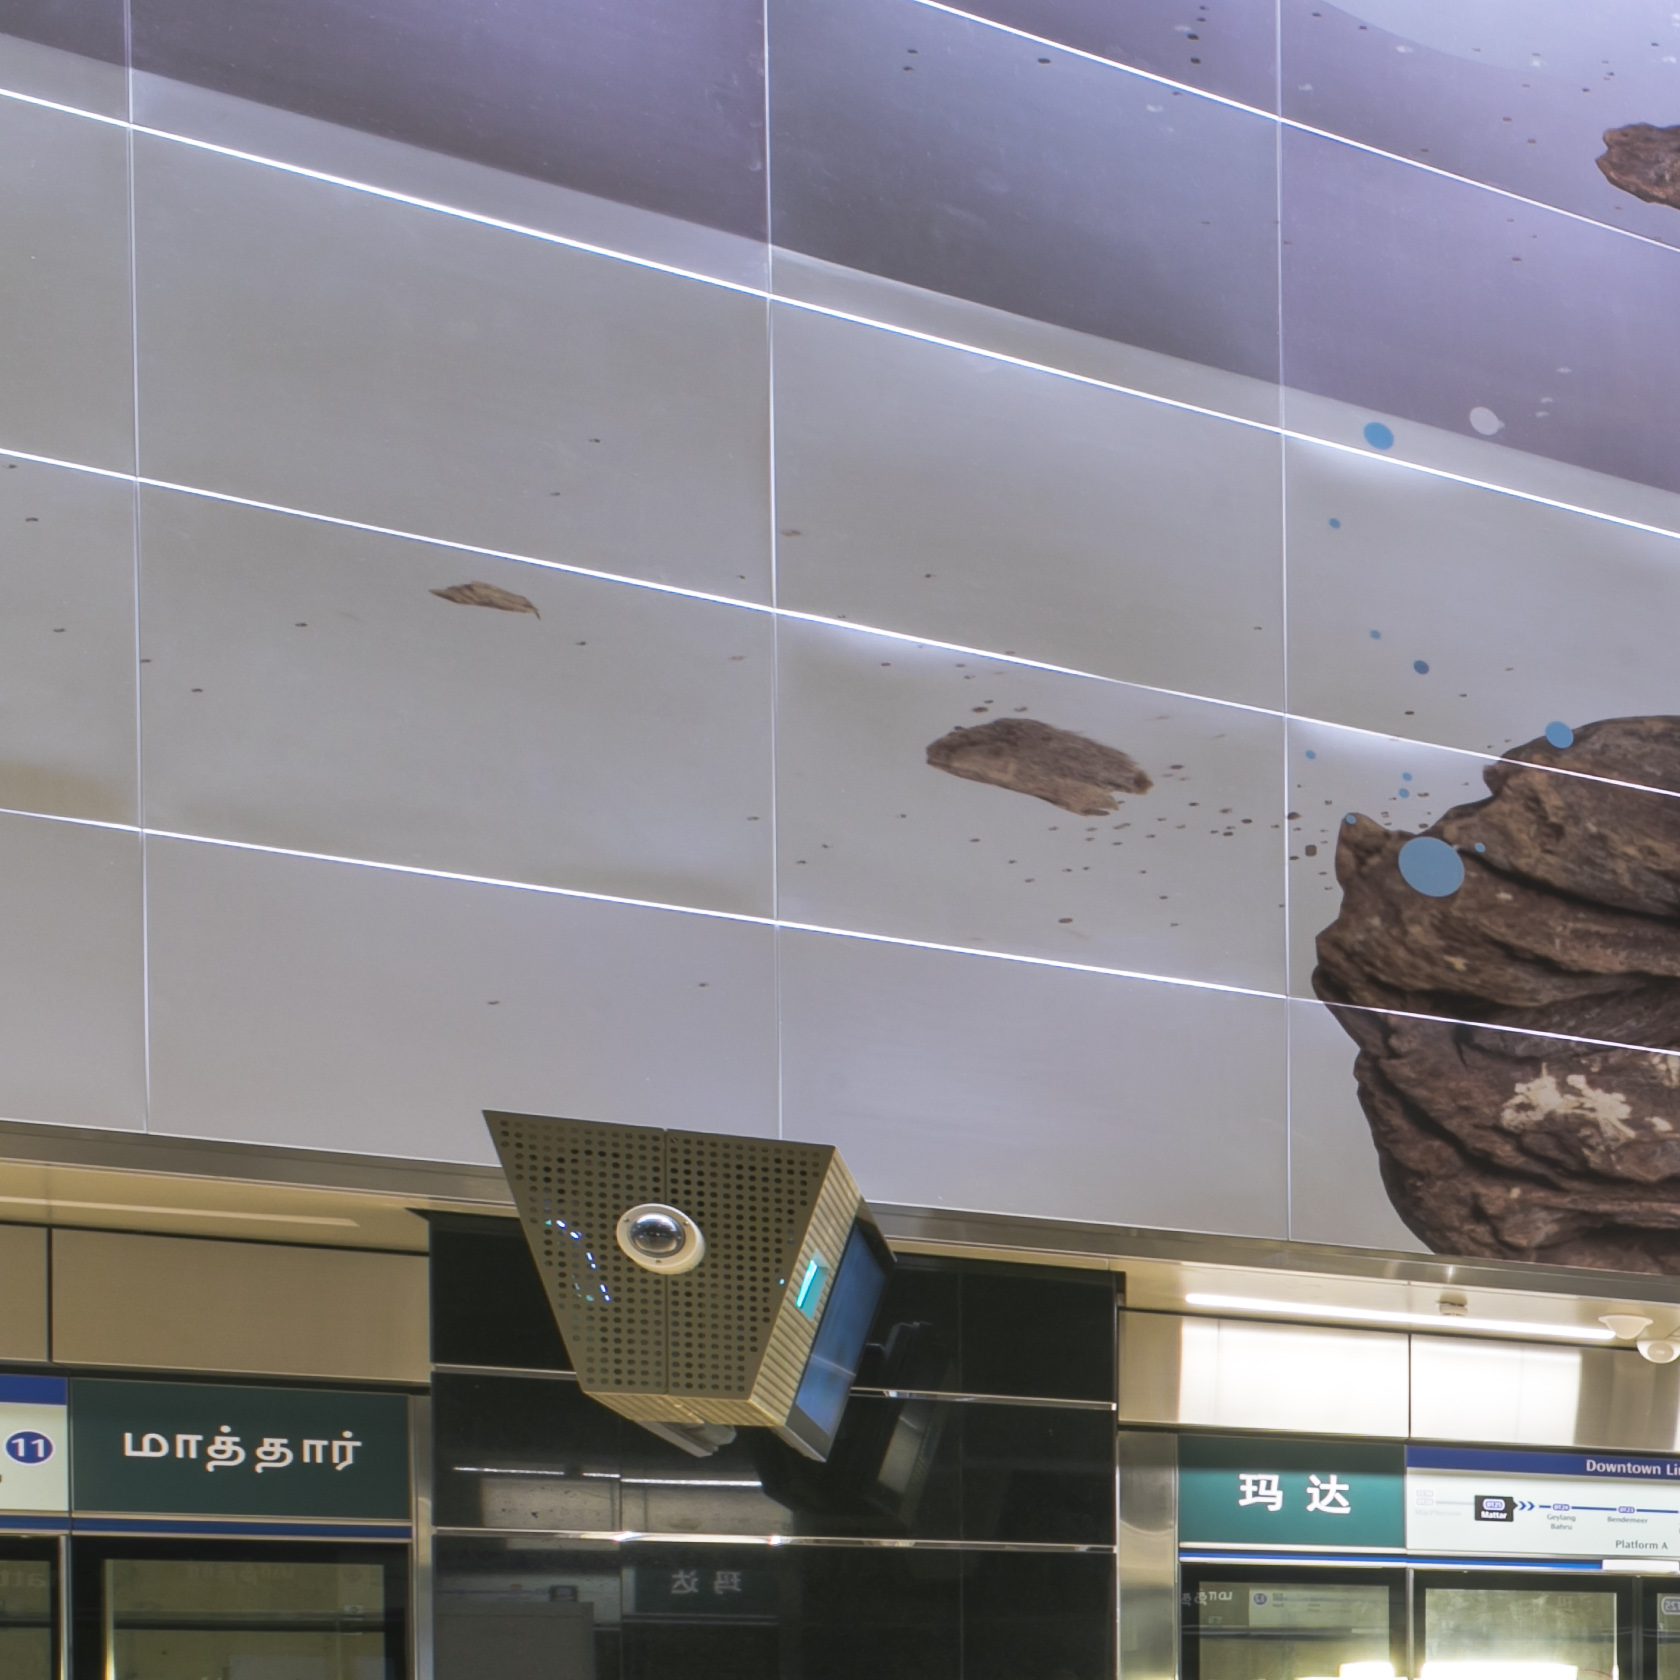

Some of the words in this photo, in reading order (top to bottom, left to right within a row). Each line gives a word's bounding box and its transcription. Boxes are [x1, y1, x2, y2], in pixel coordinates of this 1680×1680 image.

[11, 1437, 46, 1458] 11
[123, 1425, 362, 1473] மாத்தார்
[1586, 1459, 1661, 1475] Downtown
[1238, 1473, 1351, 1514] 玛达
[1480, 1511, 1507, 1519] Mattar
[1547, 1514, 1576, 1522] Geylang
[1607, 1516, 1648, 1524] Bendemeer
[1615, 1540, 1658, 1549] Platform
[1661, 1542, 1668, 1550] A
